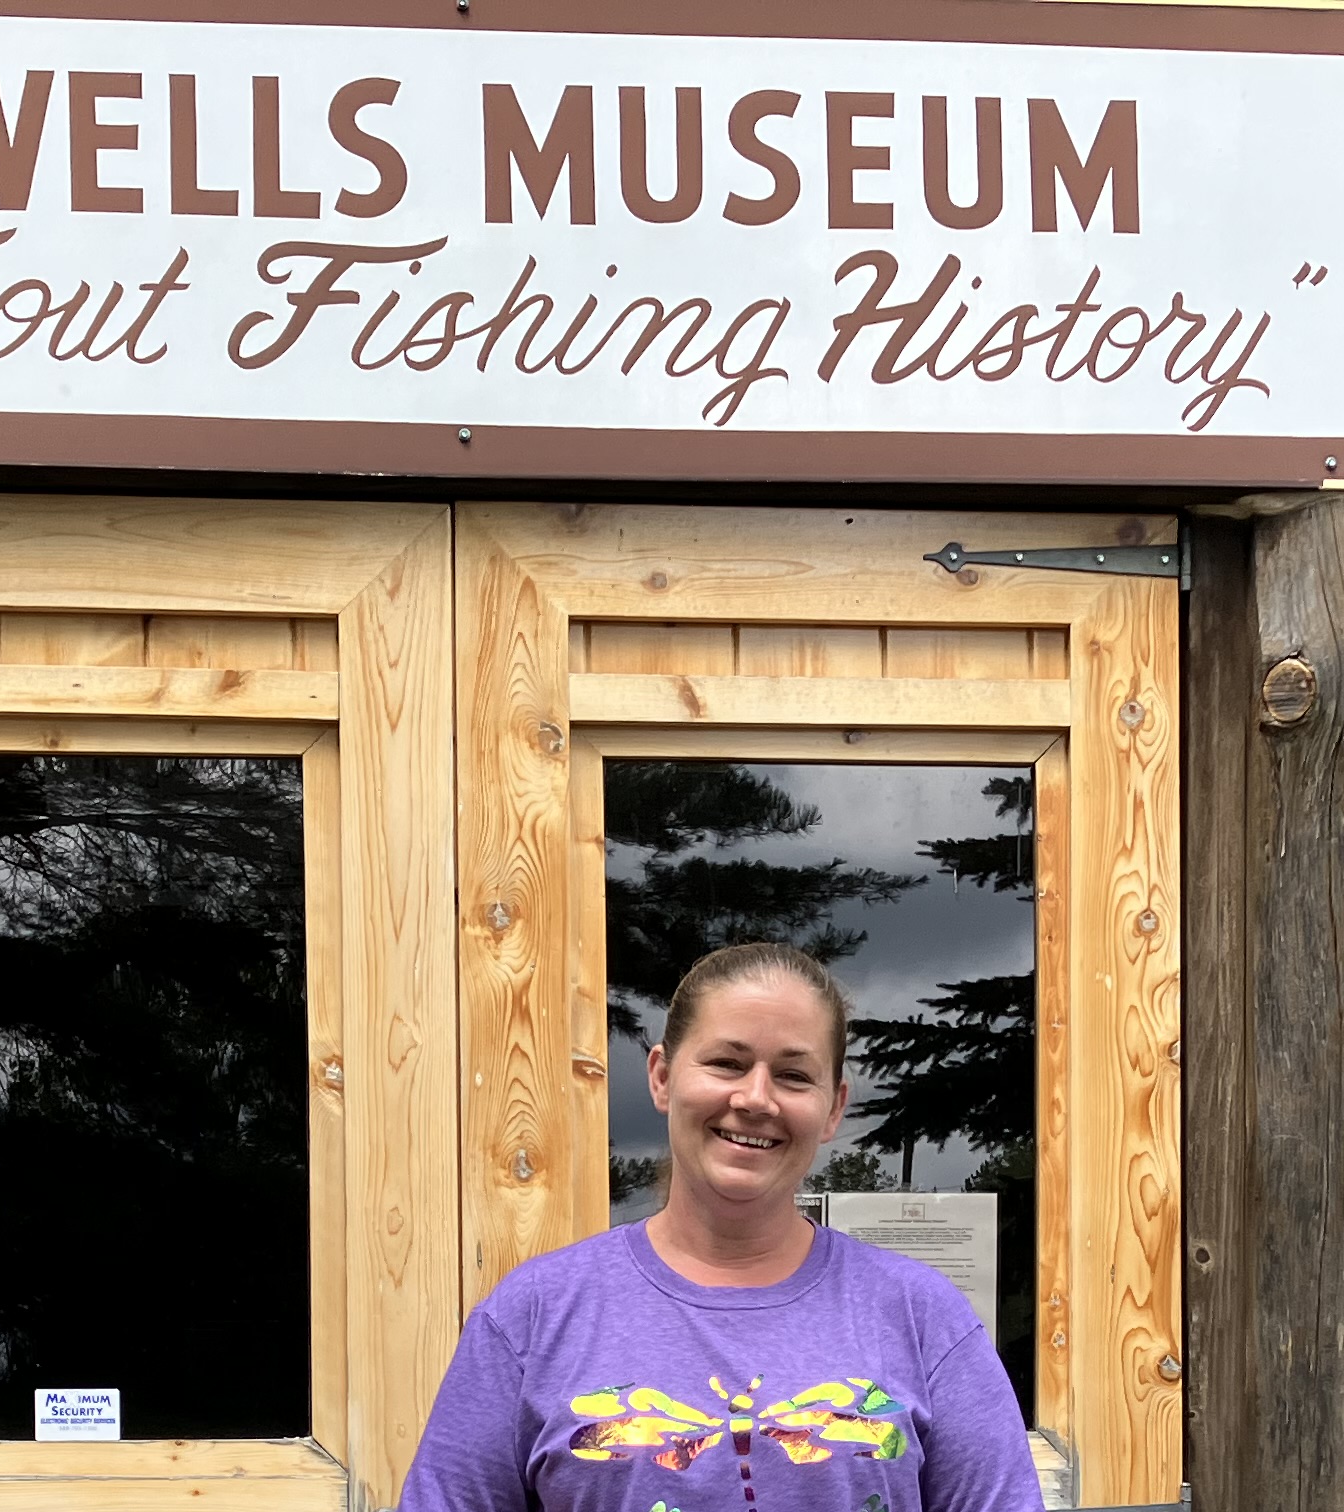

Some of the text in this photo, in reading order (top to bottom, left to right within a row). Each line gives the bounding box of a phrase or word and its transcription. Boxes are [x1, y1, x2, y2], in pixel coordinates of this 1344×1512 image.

[481, 84, 1142, 236] MUSEUM
[227, 236, 791, 428] Fishing
[45, 1393, 112, 1407] MAIMUM
[51, 1406, 104, 1416] SECURITY
